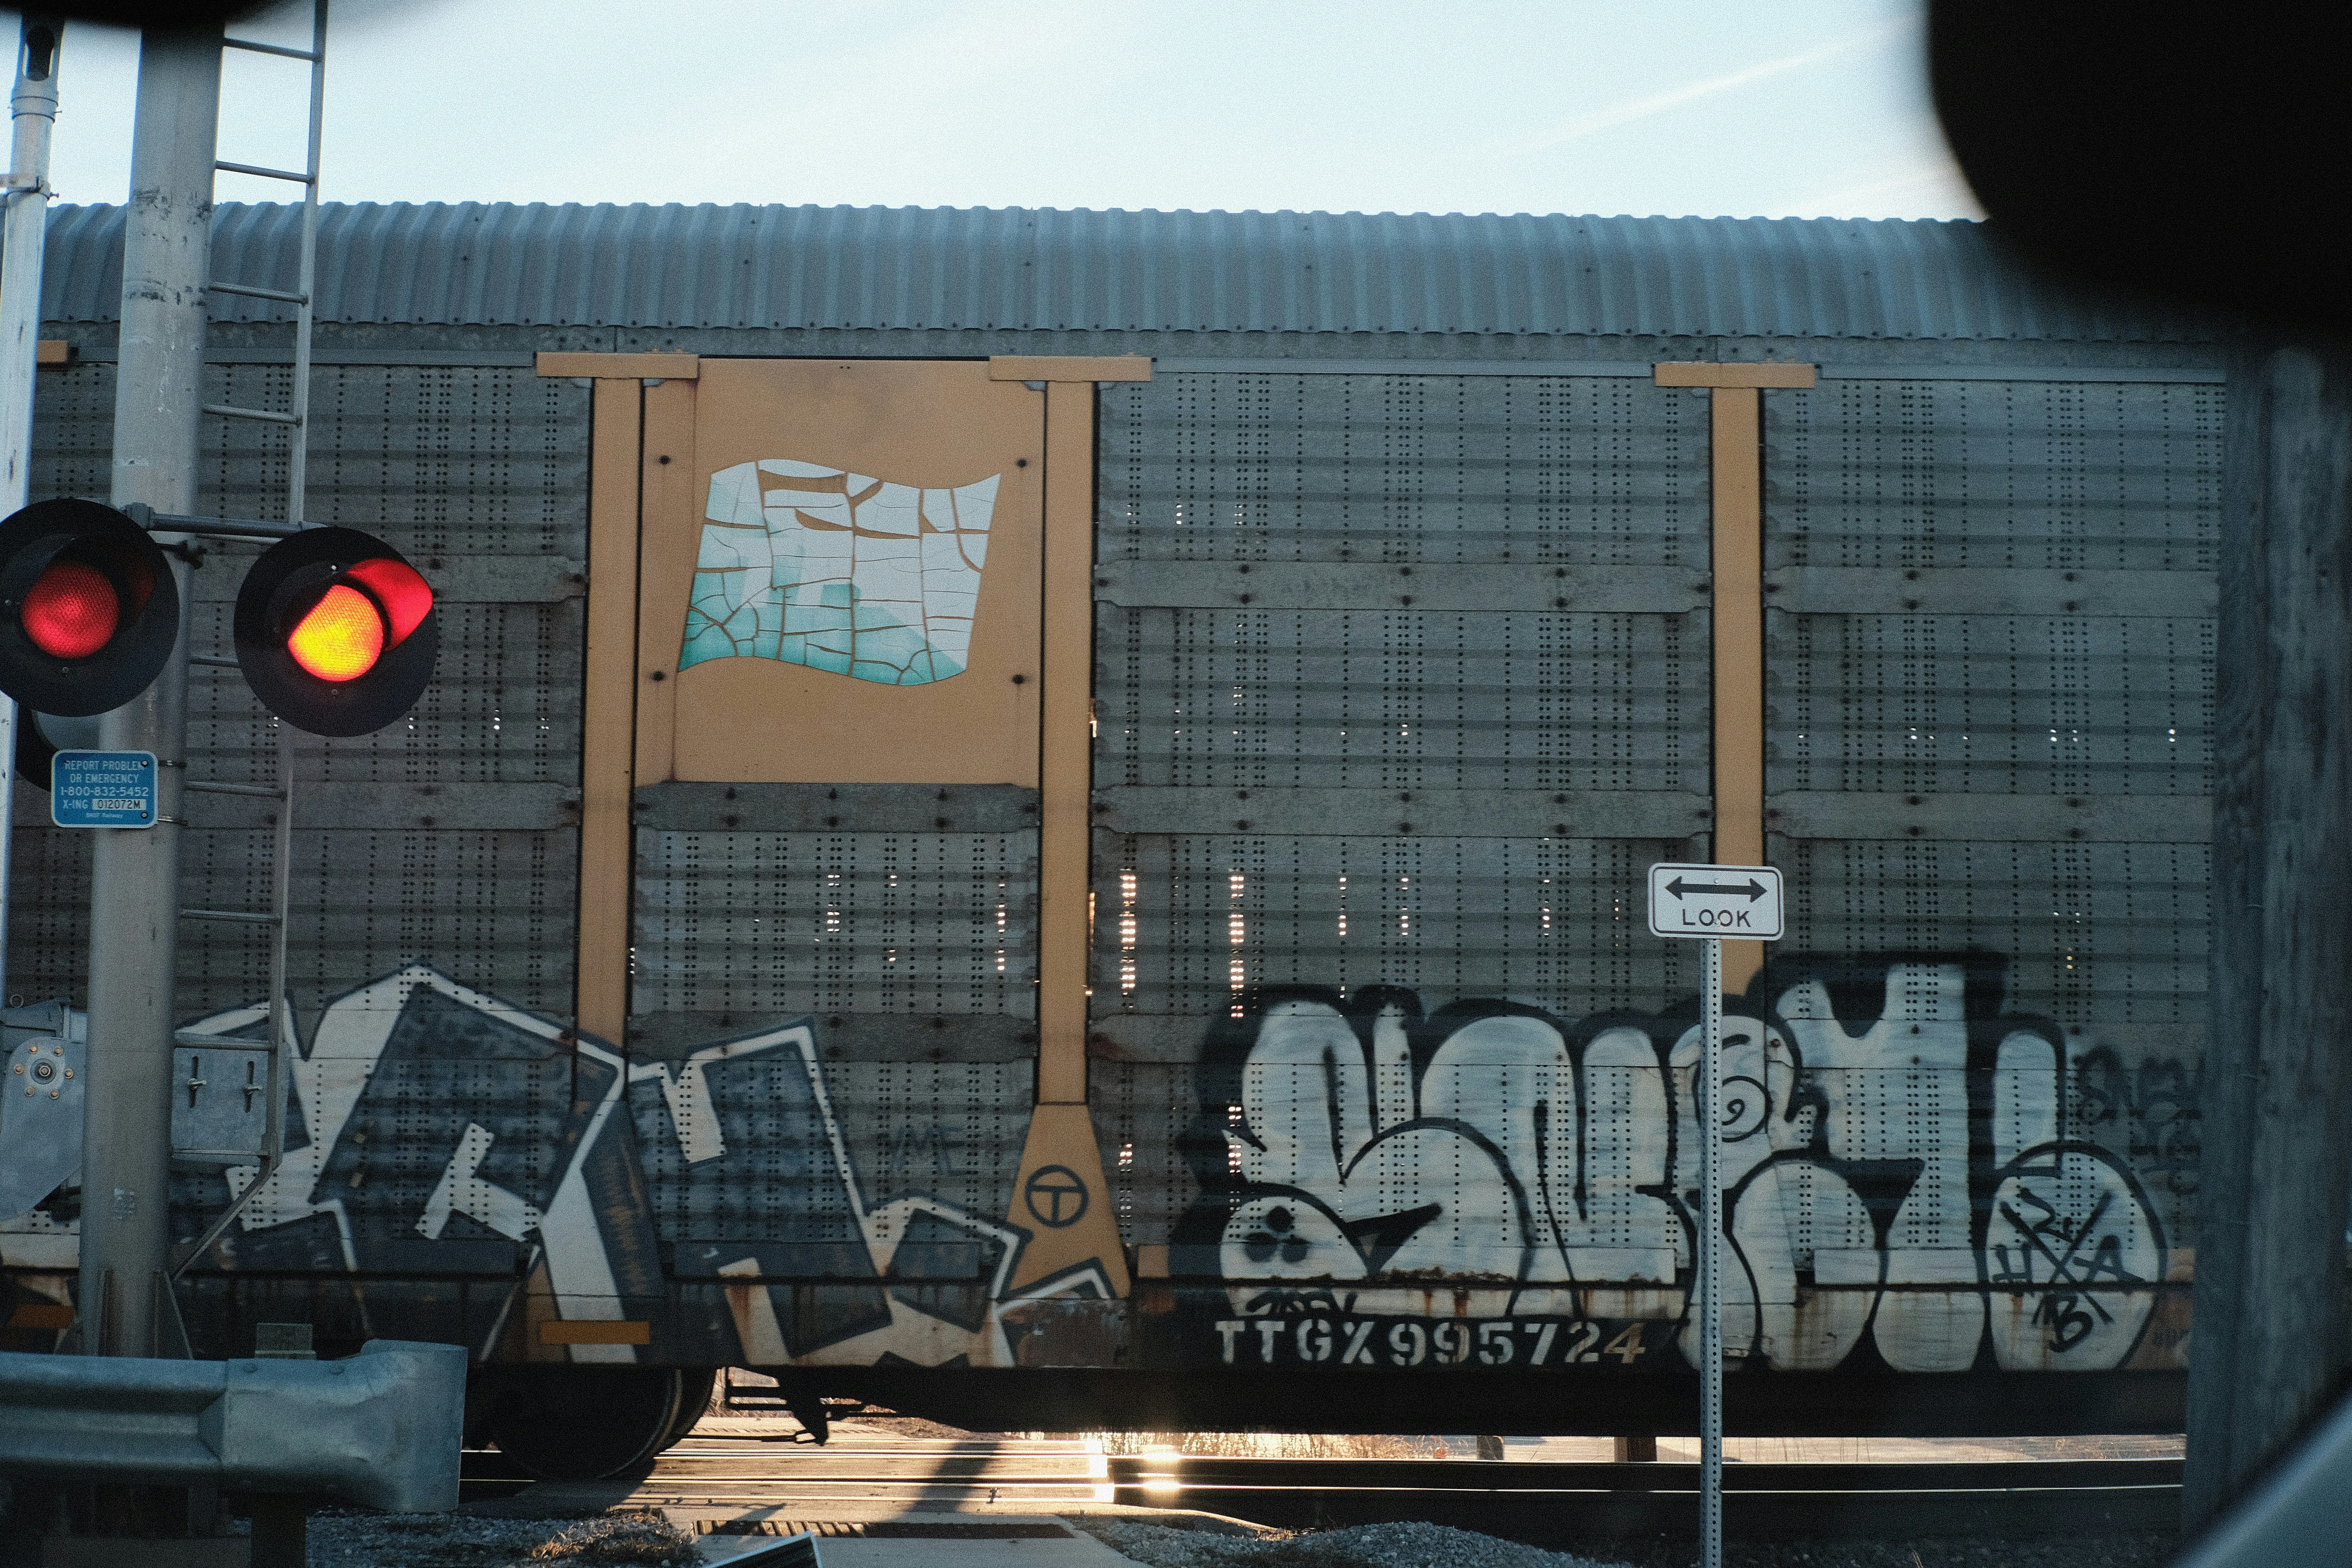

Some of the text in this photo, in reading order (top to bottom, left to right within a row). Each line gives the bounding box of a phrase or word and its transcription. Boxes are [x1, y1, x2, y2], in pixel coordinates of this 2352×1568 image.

[65, 760, 99, 770] REPORT
[70, 774, 139, 783] OR EMERGENCY
[61, 787, 149, 796] 1-800-832-5452
[63, 800, 140, 809] X-ING 012072M
[1682, 909, 1751, 927] LOOK
